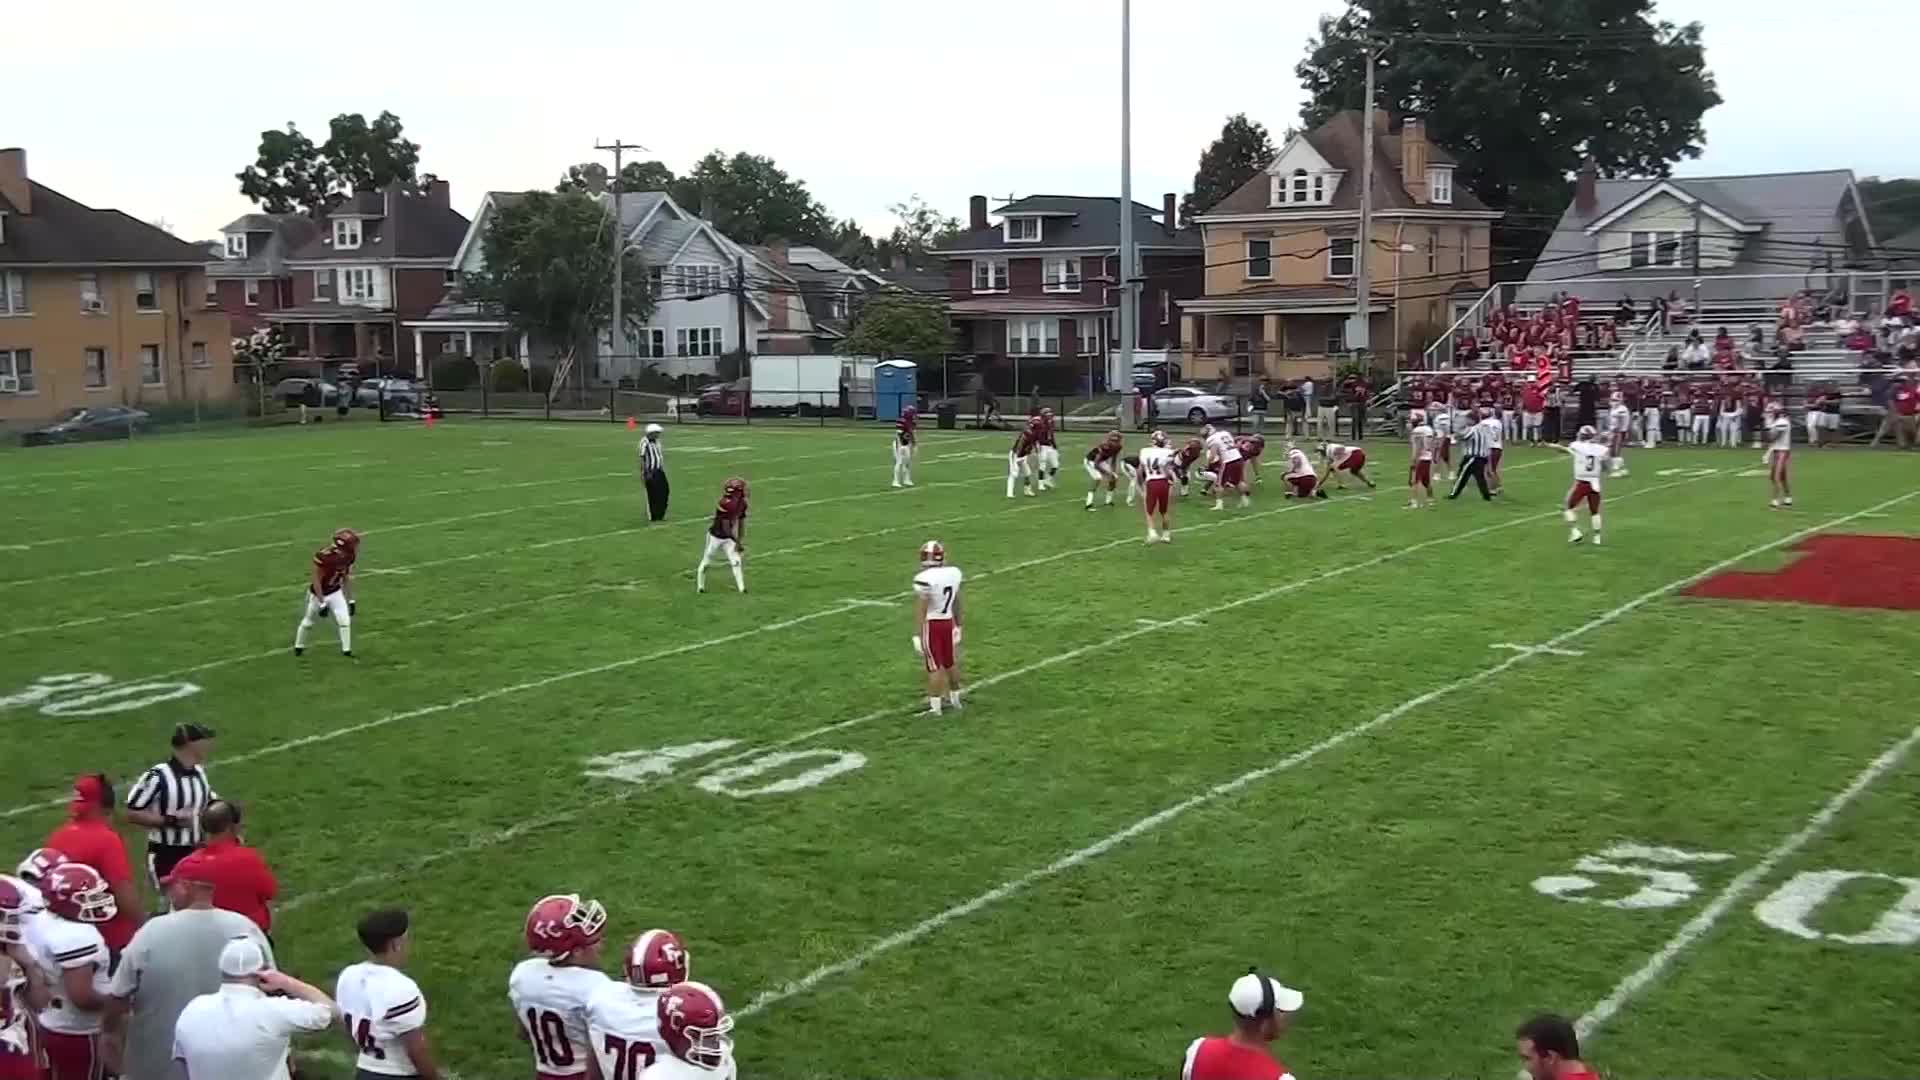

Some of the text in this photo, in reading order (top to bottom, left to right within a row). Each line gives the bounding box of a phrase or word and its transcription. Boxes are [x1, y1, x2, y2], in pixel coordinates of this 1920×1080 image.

[1585, 455, 1595, 472] 3
[943, 585, 953, 614] 7
[583, 738, 868, 798] 40
[1530, 840, 1920, 945] 50
[527, 1007, 574, 1067] 10
[604, 1033, 656, 1080] 70
